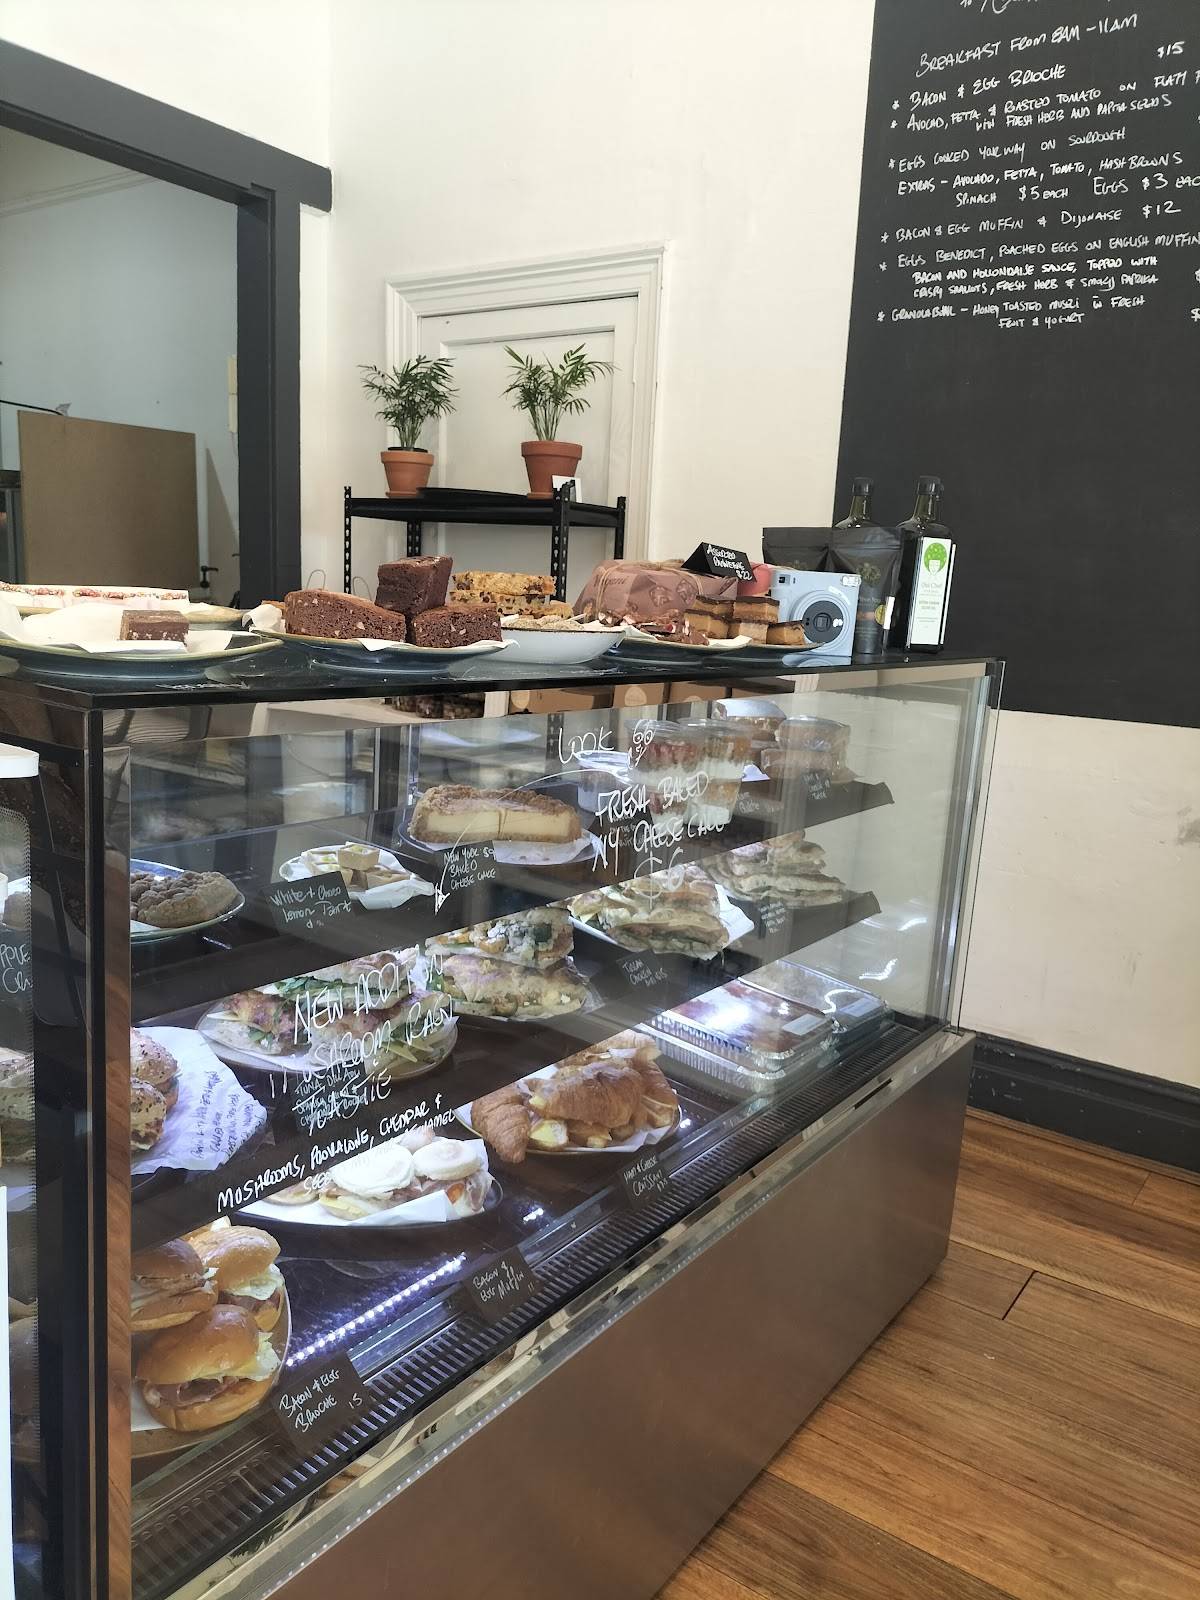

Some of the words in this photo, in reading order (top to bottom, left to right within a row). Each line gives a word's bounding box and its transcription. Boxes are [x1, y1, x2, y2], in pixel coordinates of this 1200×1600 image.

[916, 41, 1001, 78] BREAKFAST
[1051, 25, 1081, 44] 8AM
[909, 91, 947, 112] BACON
[973, 77, 1001, 95] EGG
[1008, 63, 1067, 88] BRIOCHE
[1156, 41, 1185, 58] $15
[950, 109, 981, 124] FETTA
[1056, 88, 1102, 105] TOMATO
[1119, 81, 1137, 92] ON
[1006, 114, 1033, 128] FRESH
[1037, 110, 1065, 124] HERB
[1070, 107, 1091, 120] AND
[898, 155, 926, 173] EGGS
[1003, 142, 1026, 164] WAY
[1040, 139, 1056, 151] ON
[1068, 126, 1126, 147] SOURDOUGH
[897, 177, 936, 196] EXTRAS
[1099, 156, 1126, 172] HASH
[1128, 151, 1184, 170] BROWNS
[955, 192, 997, 208] SPINACH
[1042, 188, 1069, 200] EACH
[1092, 176, 1129, 196] EGGS
[895, 226, 931, 243] BACON
[947, 223, 971, 236] EGG
[978, 216, 1025, 233] MUFFIN
[1060, 209, 1123, 229] DIJONAISE
[1142, 200, 1182, 220] $12
[897, 254, 927, 269] EGGS
[999, 242, 1046, 258] POACHED
[1051, 240, 1079, 254] EGGS
[1085, 239, 1102, 251] ON
[1108, 234, 1150, 250] ENGLISH
[911, 270, 943, 285] BACON
[946, 268, 968, 281] AND
[1086, 257, 1123, 271] TOPPED
[1130, 255, 1158, 267] WITH
[913, 285, 943, 300] CRISPY
[996, 279, 1027, 292] FRESH
[1033, 278, 1059, 291] HERB
[972, 303, 1000, 319] HONEY
[1003, 300, 1043, 313] TOASTED
[1110, 294, 1147, 309] FRESH
[997, 317, 1026, 329] FRUIT
[1044, 311, 1086, 330] YOGURT
[558, 726, 615, 764] LOOK
[595, 784, 651, 827] FRESH
[633, 816, 685, 853] CHEESE
[282, 907, 316, 924] Lemon
[0, 943, 31, 969] PPLE
[294, 986, 345, 1046] NEW
[279, 1386, 313, 1418] BACON
